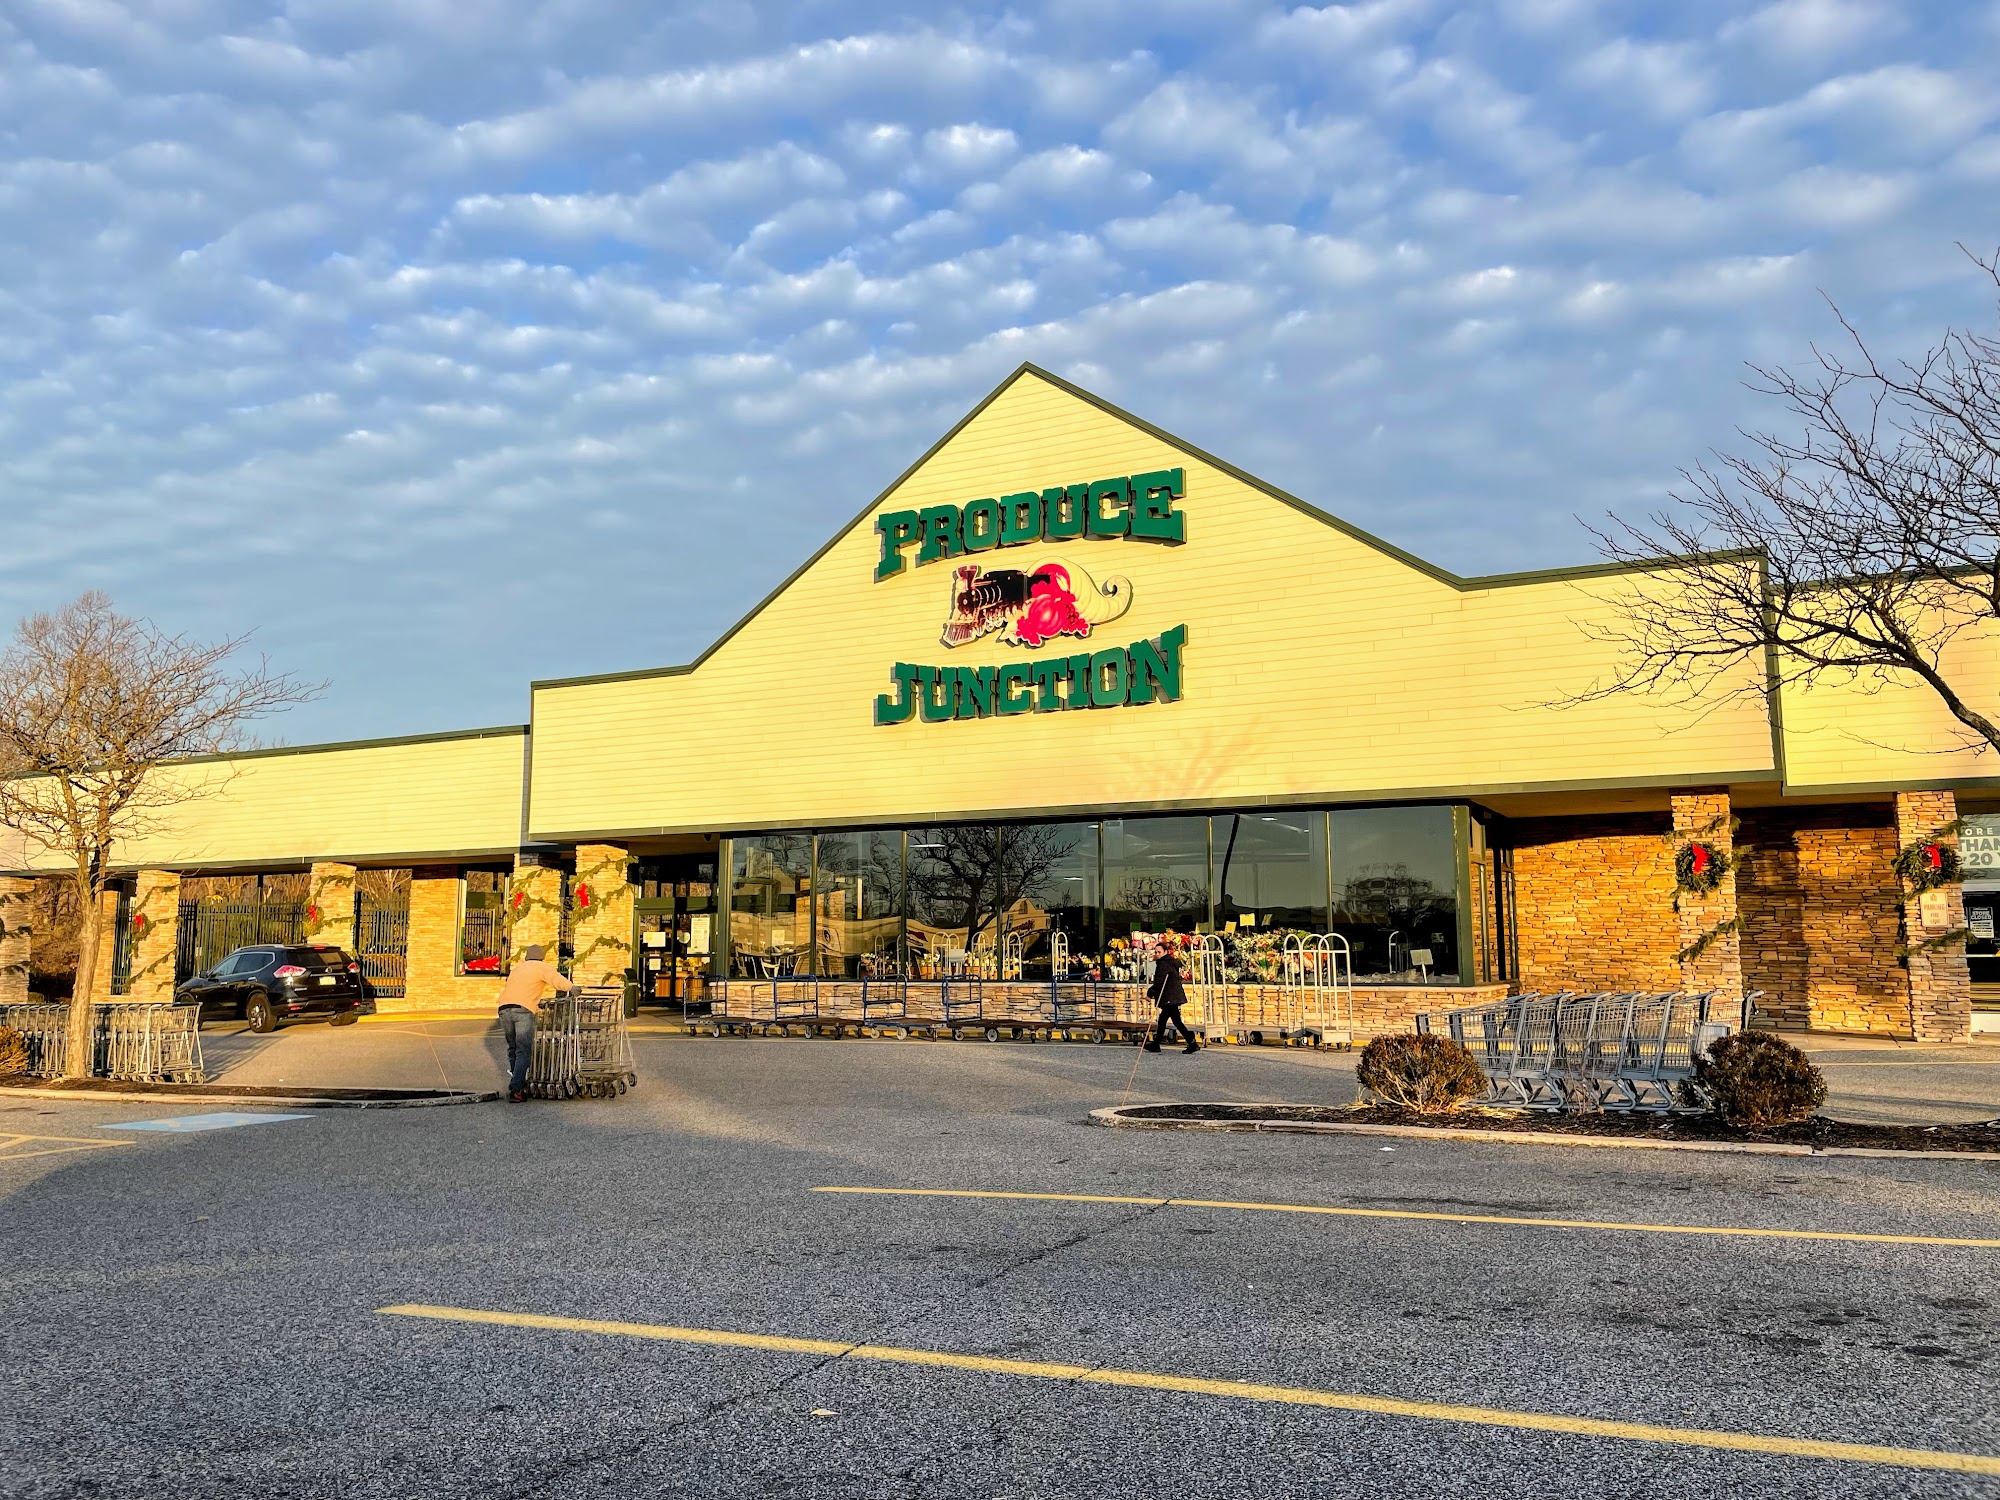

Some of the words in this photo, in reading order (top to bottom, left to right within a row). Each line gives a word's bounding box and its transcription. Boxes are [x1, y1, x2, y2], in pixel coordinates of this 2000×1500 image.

[874, 467, 1187, 584] PRODUCE
[874, 623, 1188, 727] JUNCTION
[1969, 852, 1993, 866] 20
[1923, 903, 1946, 911] PARKING
